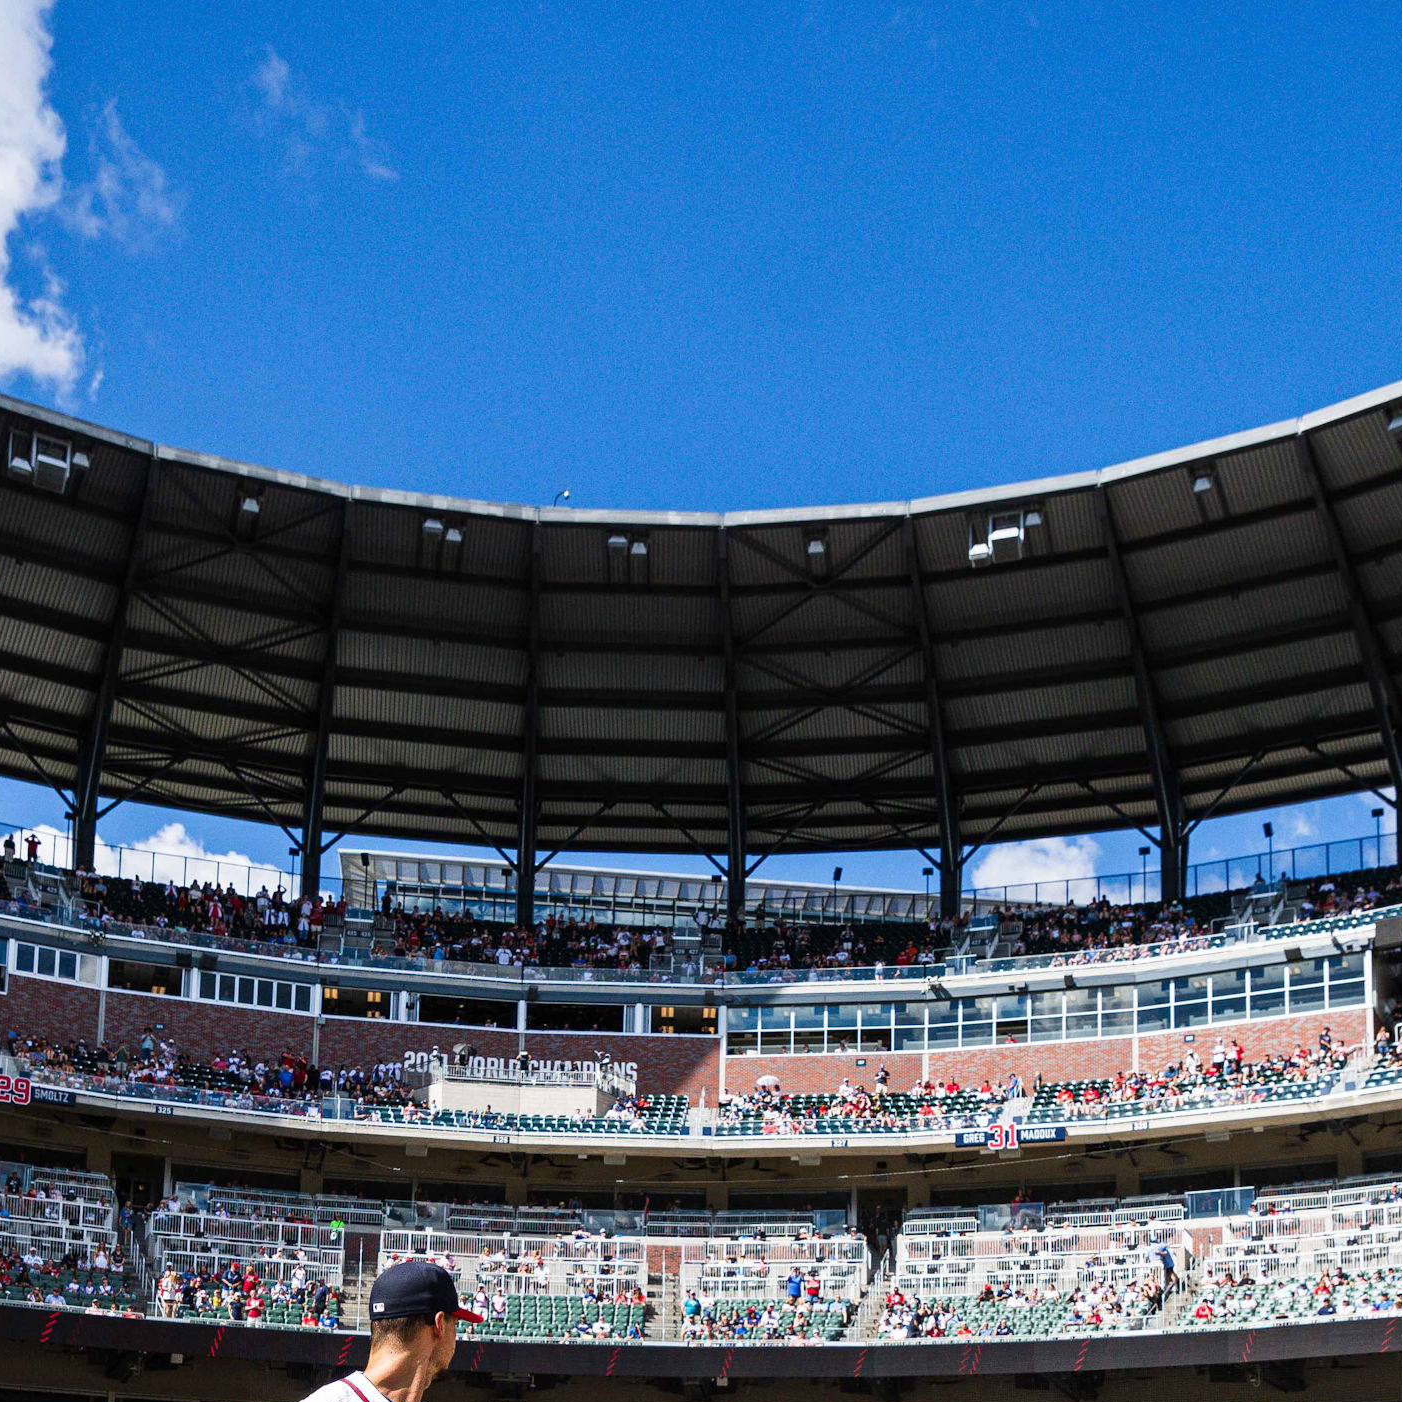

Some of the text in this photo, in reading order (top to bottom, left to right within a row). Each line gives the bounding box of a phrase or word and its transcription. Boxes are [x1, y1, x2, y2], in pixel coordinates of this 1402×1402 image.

[34, 1089, 69, 1102] SMOLTZ
[158, 1106, 172, 1115] 325
[963, 1123, 1057, 1149] GREG 31 MADDUX
